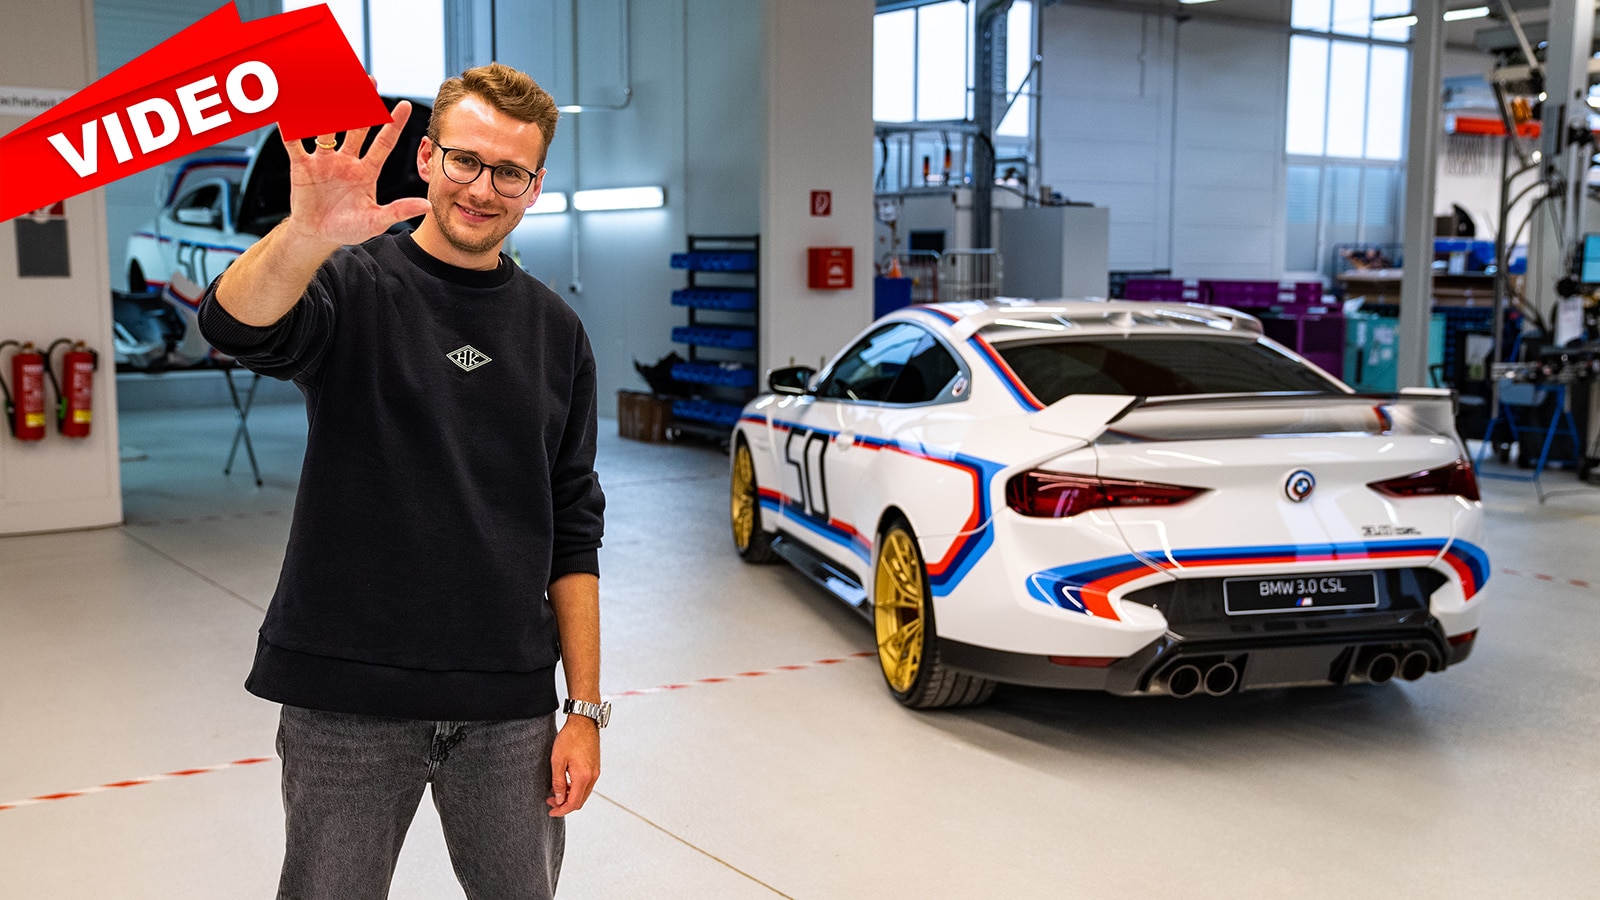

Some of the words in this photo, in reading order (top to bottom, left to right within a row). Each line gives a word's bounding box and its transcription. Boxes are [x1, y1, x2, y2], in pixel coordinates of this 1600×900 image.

[785, 426, 830, 523] 50
[1259, 580, 1294, 596] BMW
[1296, 578, 1318, 595] 3.0
[1320, 577, 1347, 593] CSL
